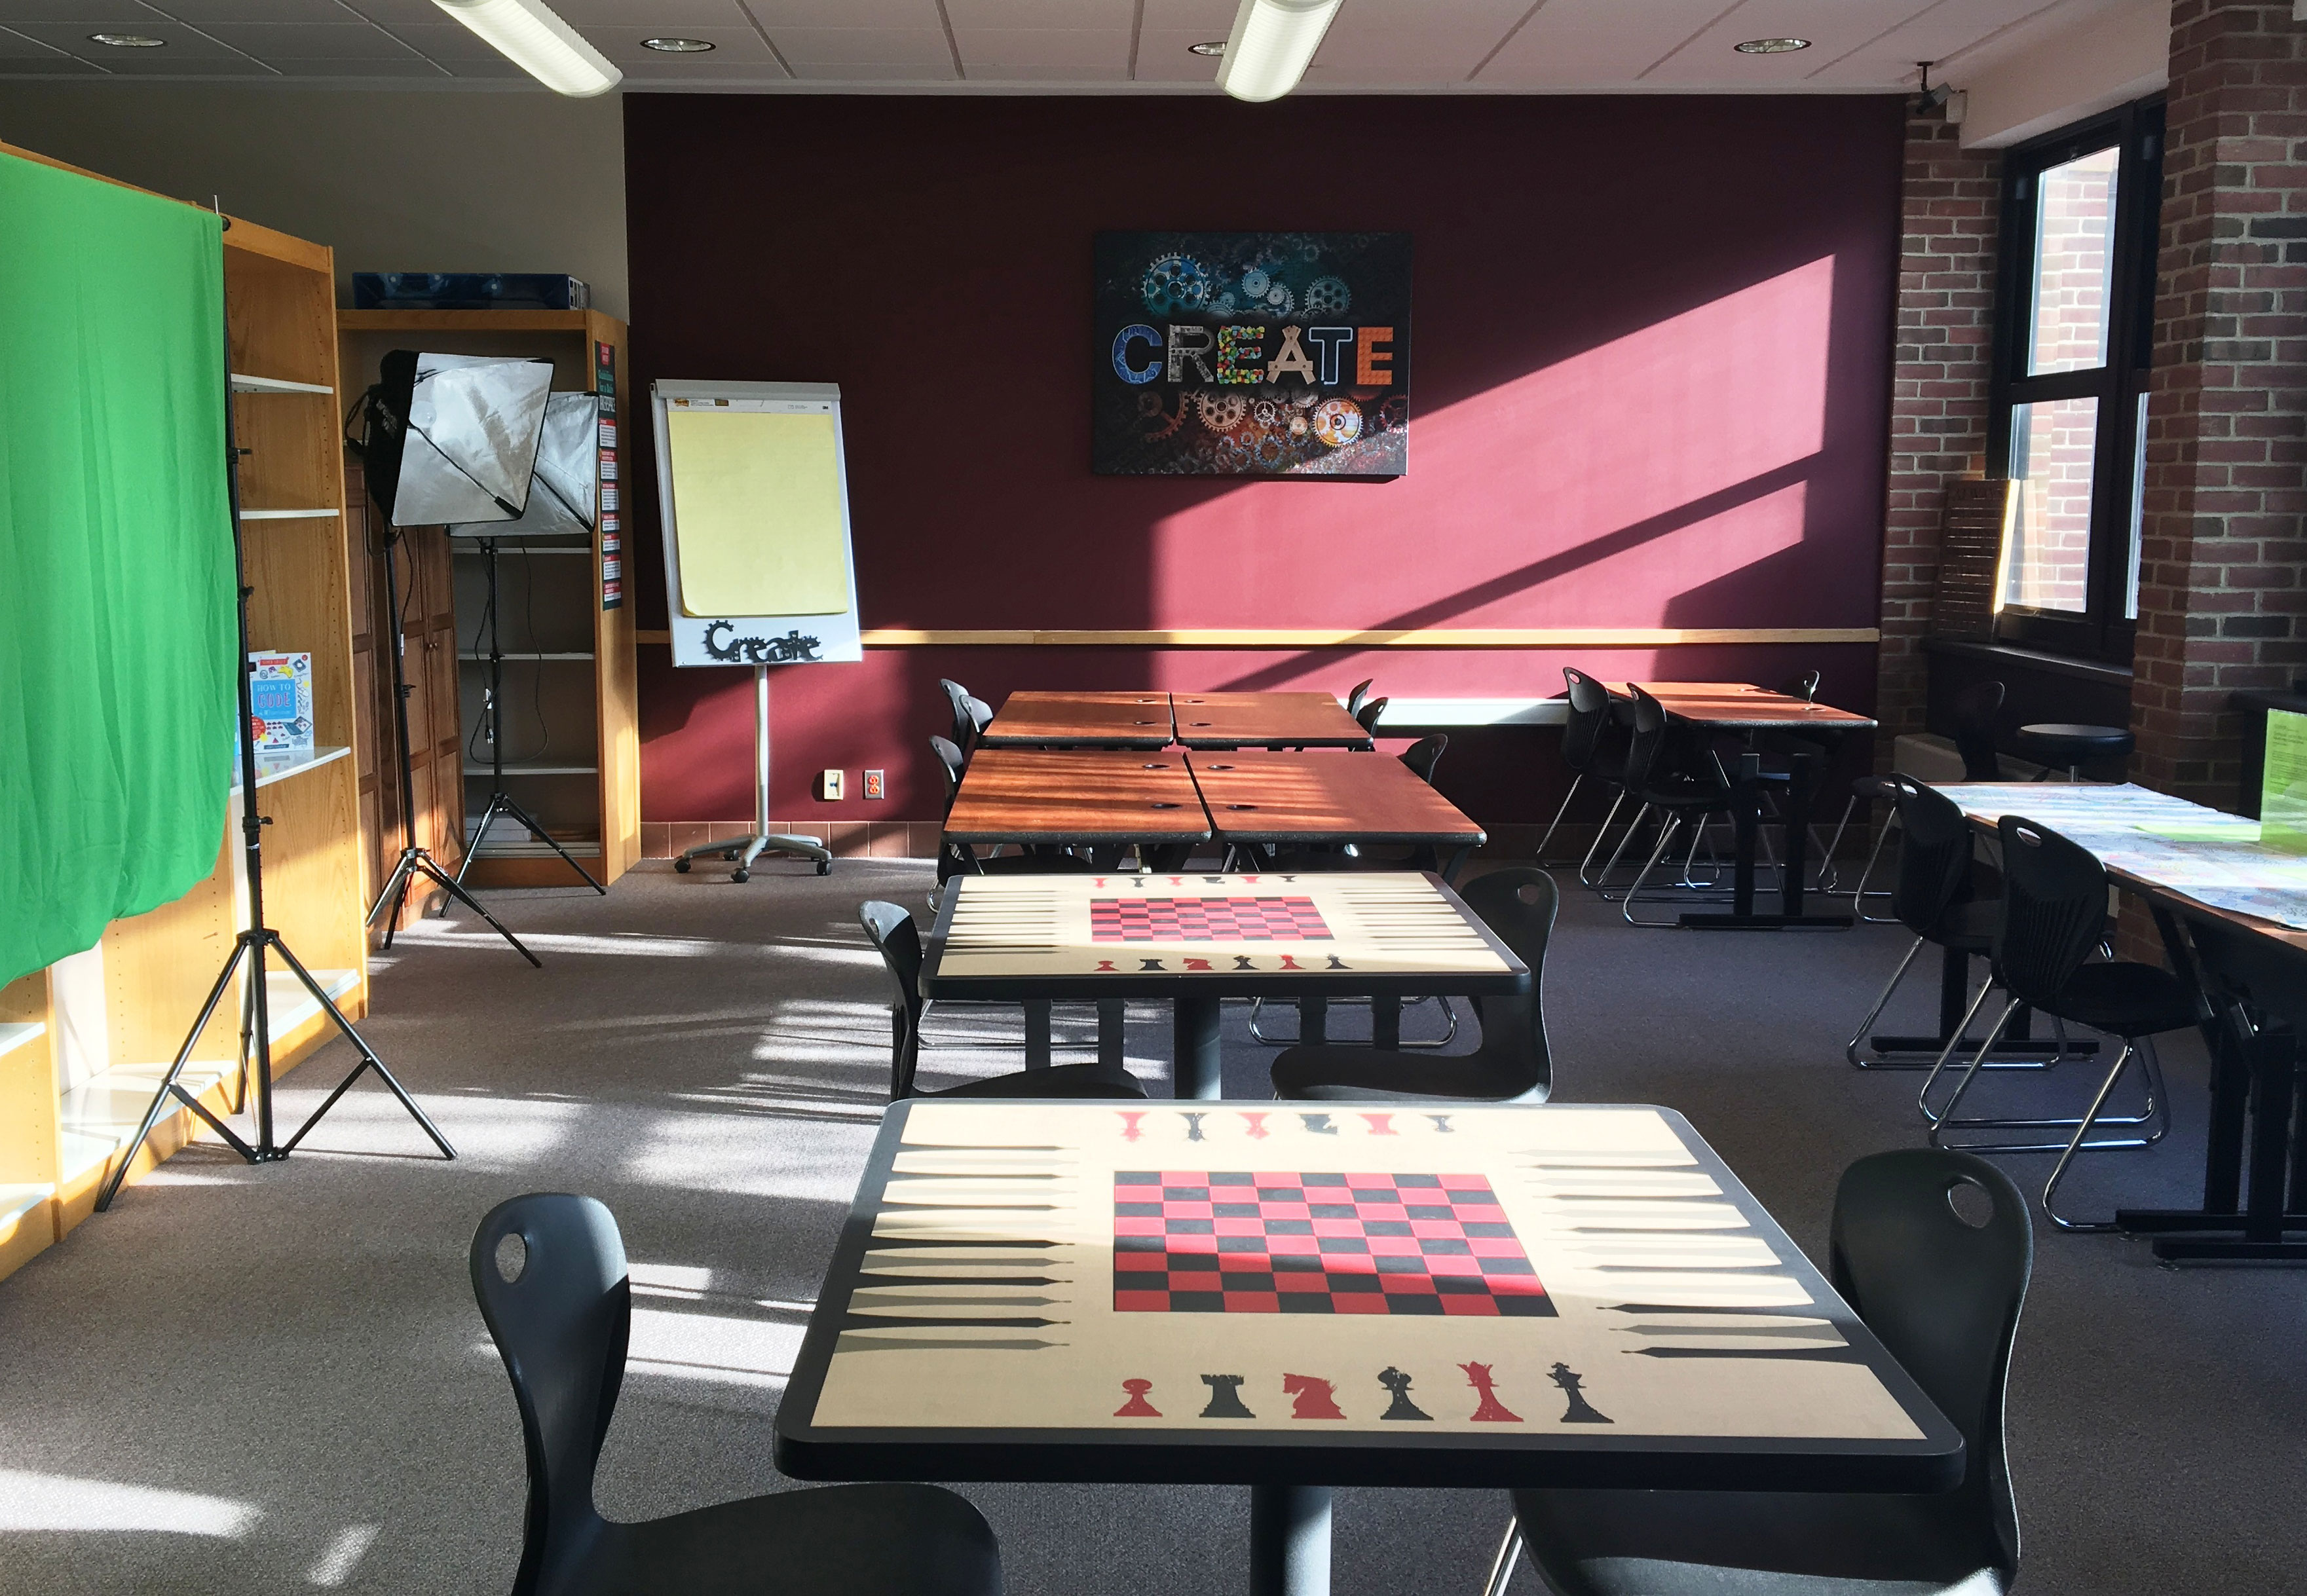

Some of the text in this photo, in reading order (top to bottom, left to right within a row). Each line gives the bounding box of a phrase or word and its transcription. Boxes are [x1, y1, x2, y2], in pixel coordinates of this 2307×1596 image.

[1112, 324, 1394, 385] CREATE
[702, 620, 823, 663] Create
[259, 692, 291, 707] CODE
